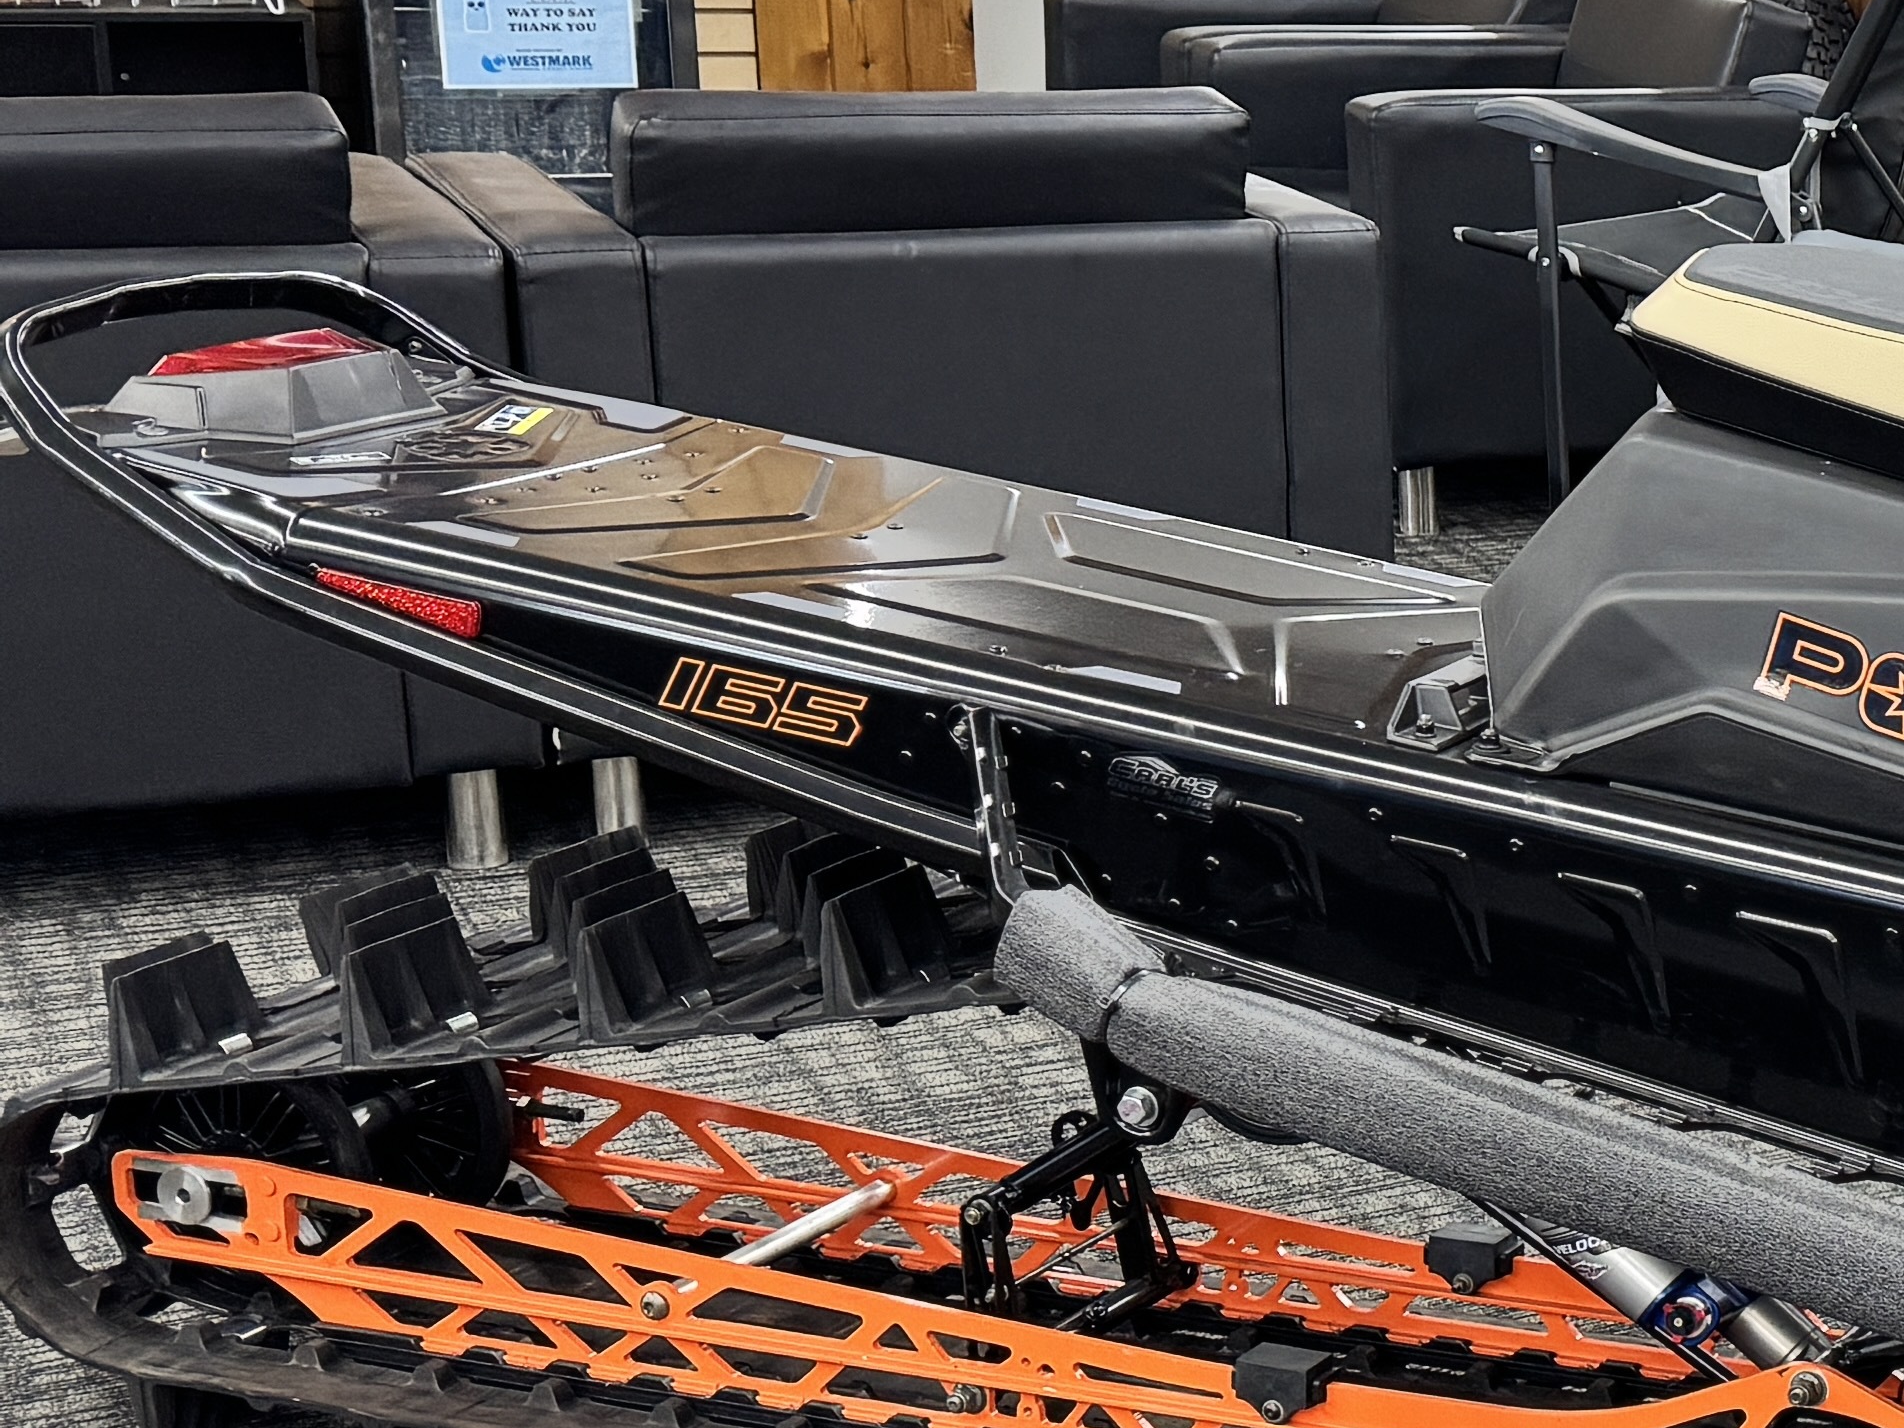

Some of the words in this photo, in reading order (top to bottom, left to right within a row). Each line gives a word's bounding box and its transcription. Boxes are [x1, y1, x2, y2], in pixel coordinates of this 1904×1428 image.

[506, 8, 539, 18] WAY
[545, 8, 564, 18] TO
[568, 9, 596, 18] SAY
[507, 22, 562, 33] THANK
[568, 23, 597, 32] YOU
[507, 54, 592, 68] WESTMARK
[658, 655, 869, 748] 165
[1109, 756, 1218, 799] CARL'S
